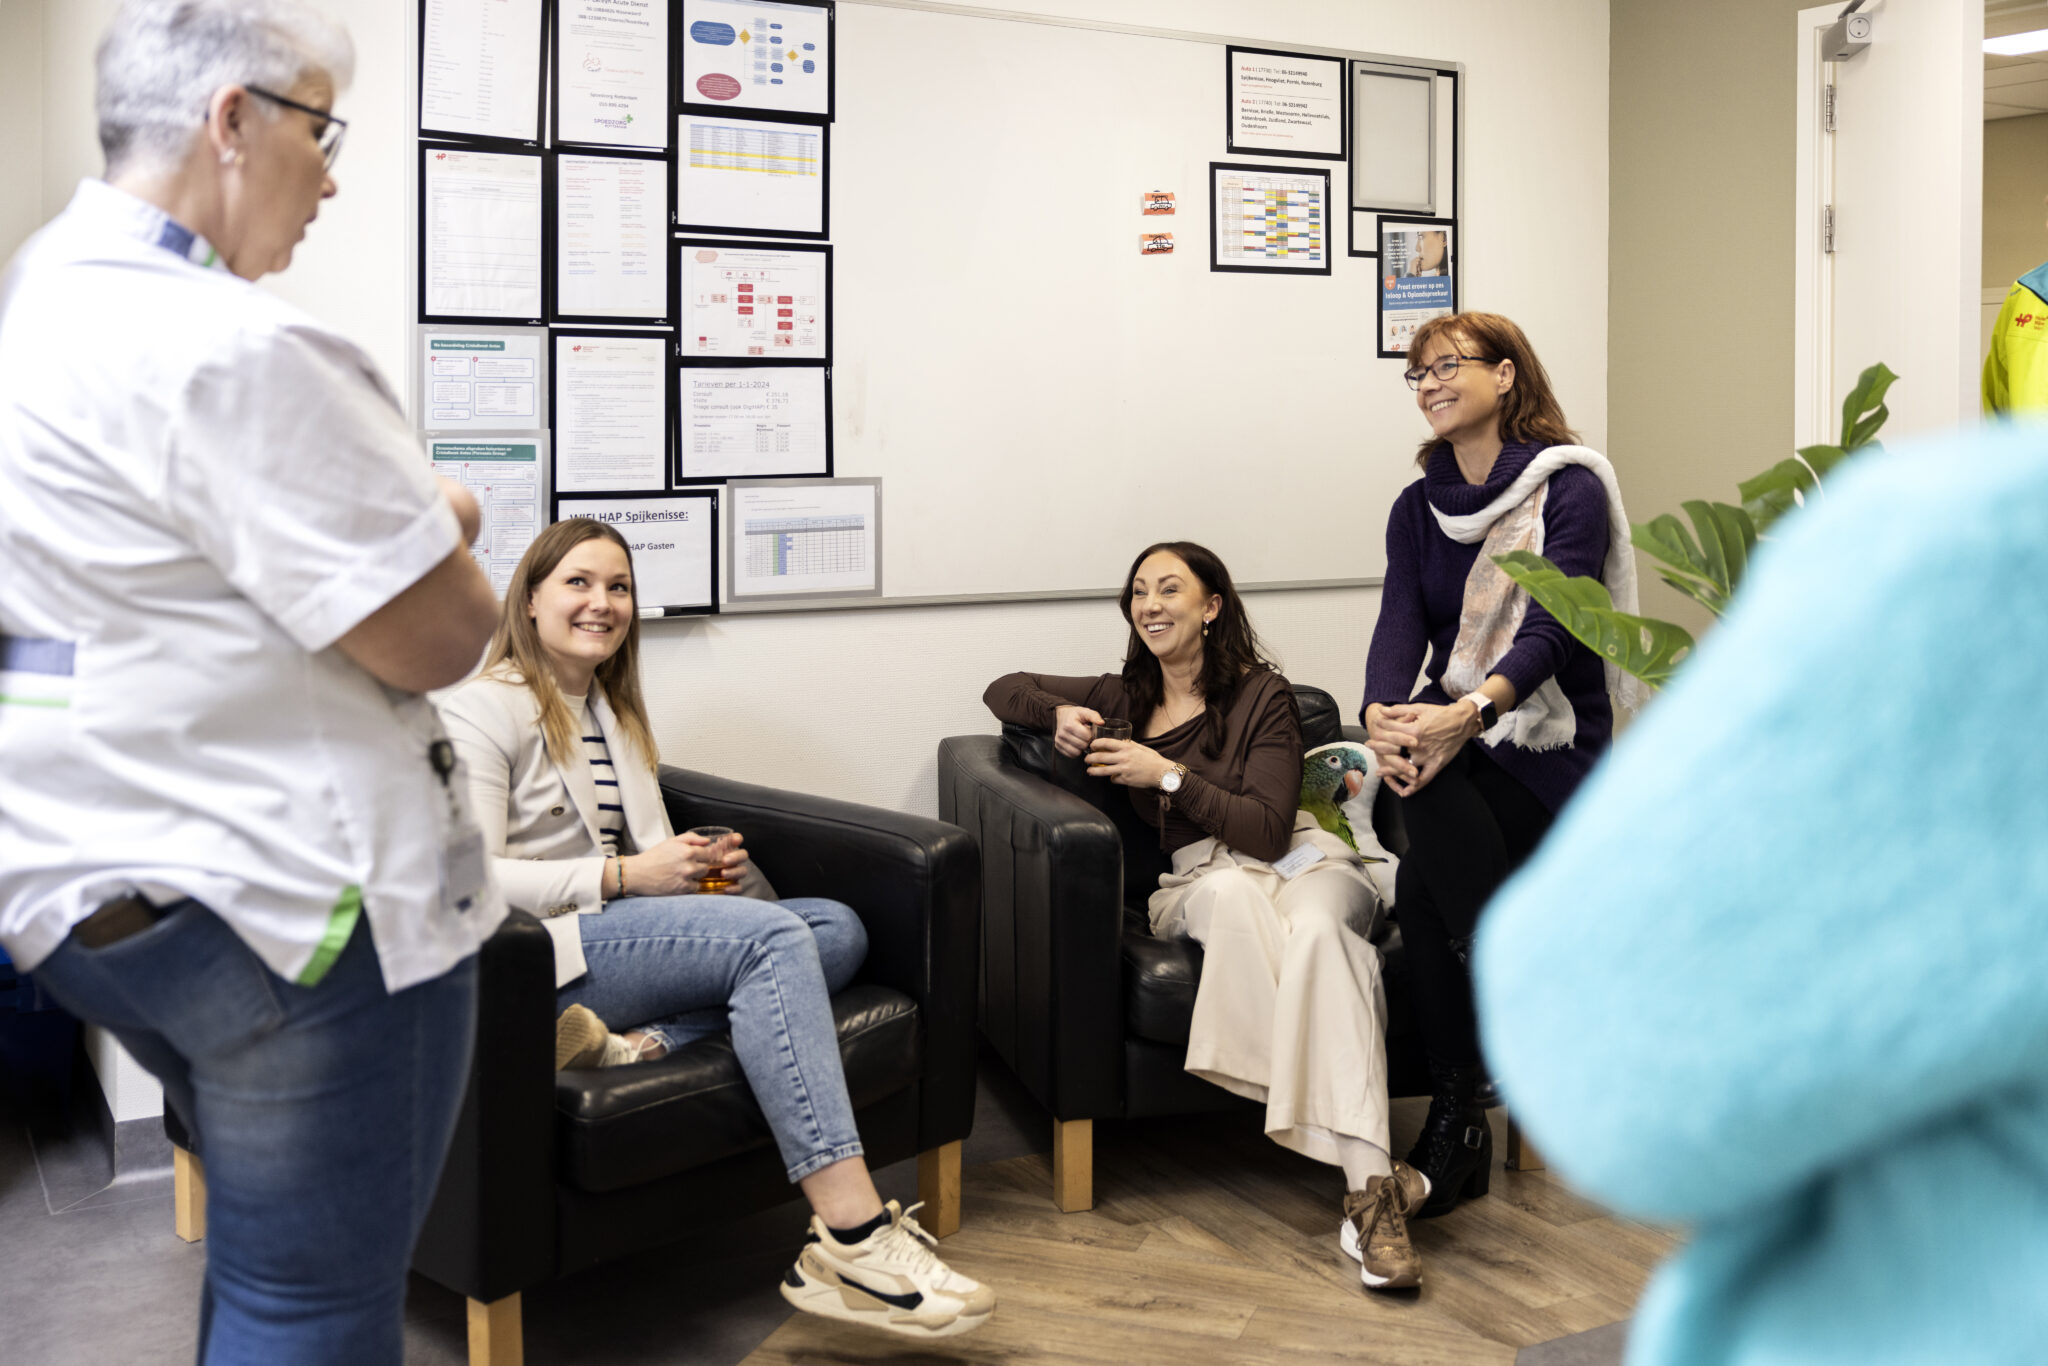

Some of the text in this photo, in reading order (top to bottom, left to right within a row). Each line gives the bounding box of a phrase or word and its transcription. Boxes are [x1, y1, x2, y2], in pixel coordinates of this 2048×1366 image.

[693, 380, 723, 388] Tarieven
[739, 380, 770, 388] 1-1-2024
[599, 512, 623, 522] HAP
[625, 509, 689, 524] Spijkenisse:
[647, 542, 675, 551] Gasten
